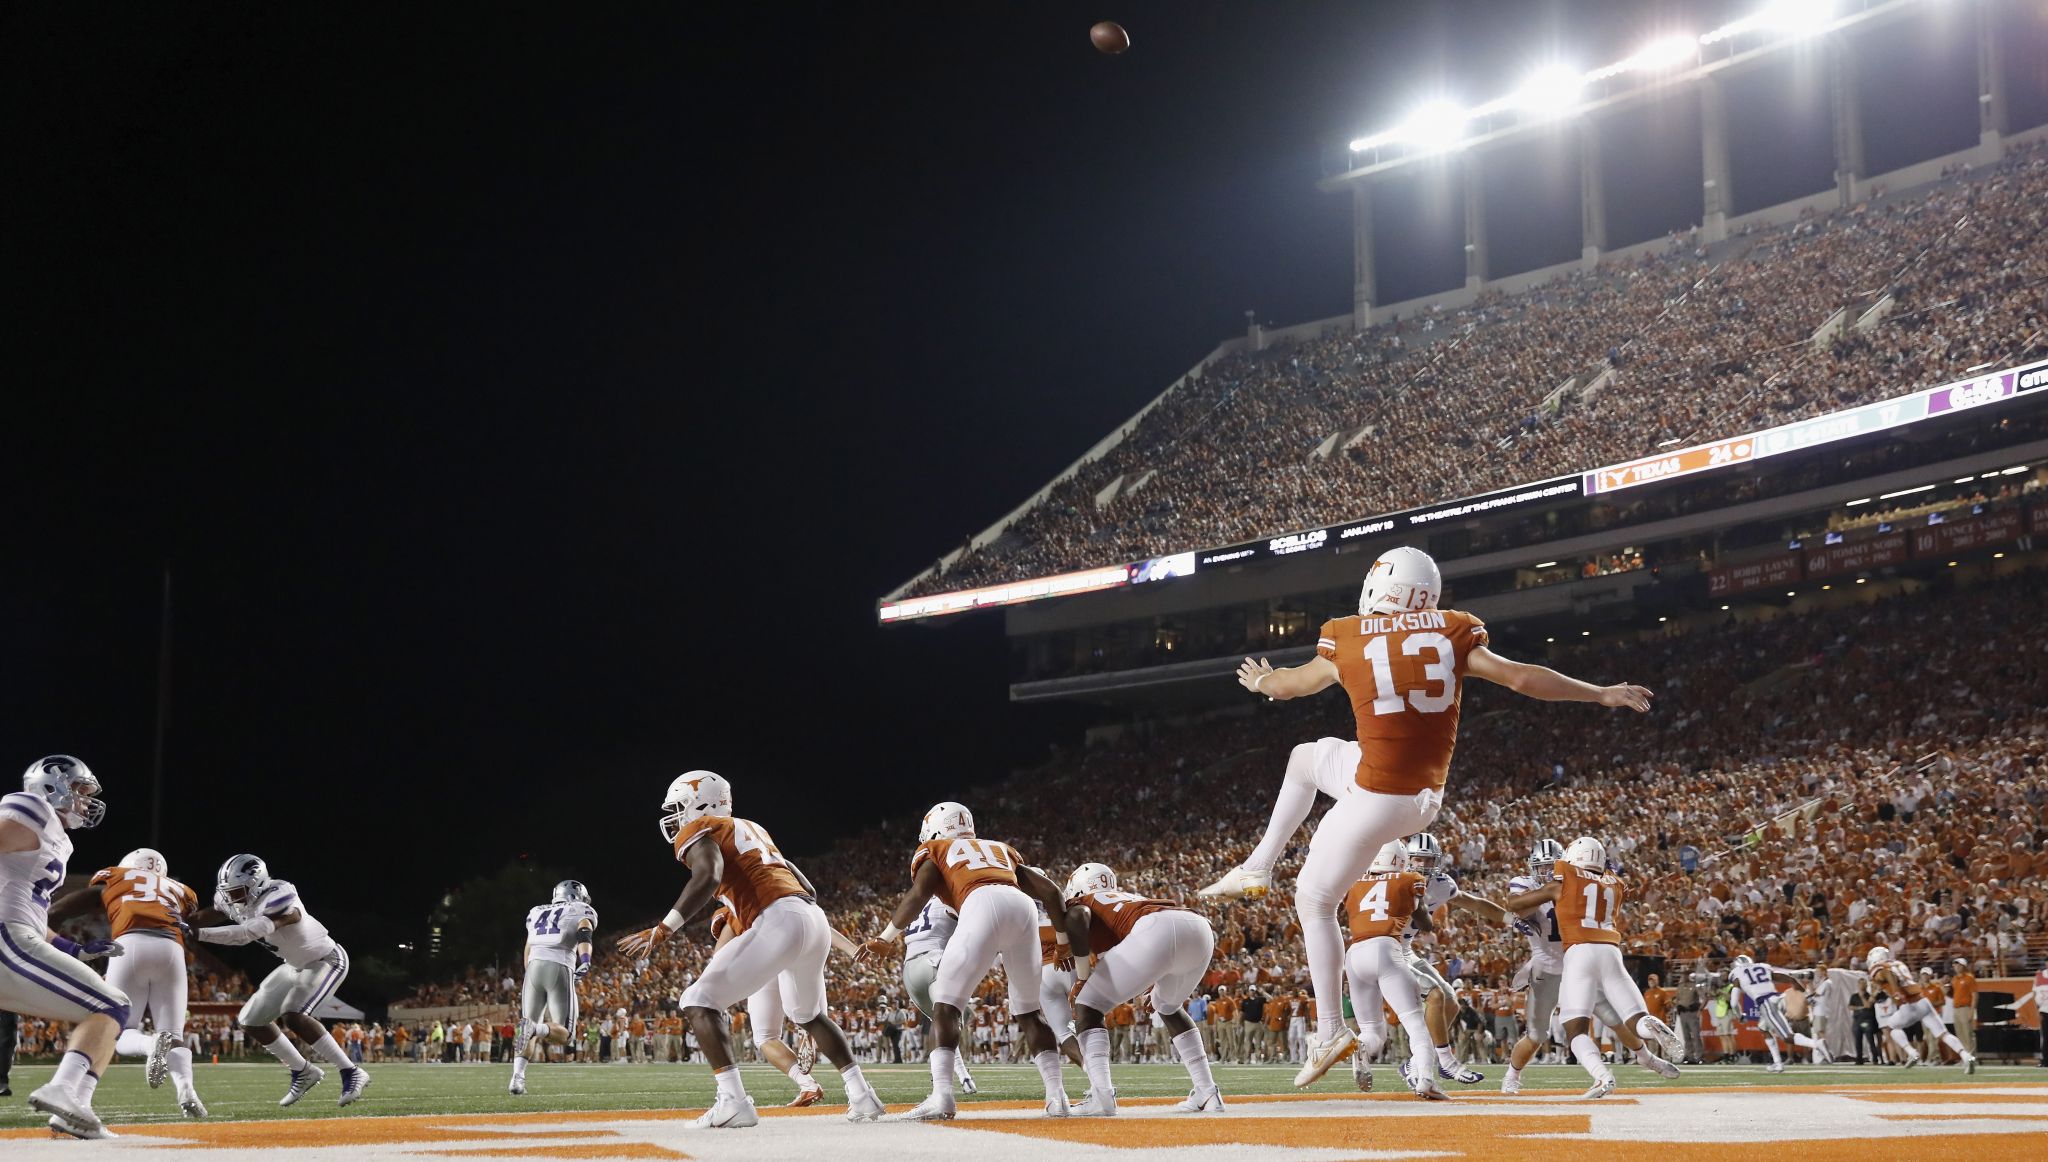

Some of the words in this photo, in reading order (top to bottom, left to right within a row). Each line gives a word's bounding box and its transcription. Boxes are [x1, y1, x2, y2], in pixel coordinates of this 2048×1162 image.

[1633, 457, 1681, 482] TEXAS
[1709, 446, 1732, 466] 24
[1410, 515, 1426, 524] THE
[1473, 502, 1489, 512] THE
[1489, 496, 1516, 508] FRANK
[1543, 483, 1577, 496] CENTER
[1341, 522, 1383, 538] JANUARY
[1941, 522, 1975, 538] VINCE
[1832, 544, 1869, 560] TOMMY
[1918, 535, 1934, 551] 10
[1212, 551, 1240, 563] EVENING
[1764, 559, 1796, 573] LAYNE
[1809, 555, 1826, 572] 60
[1711, 575, 1727, 591] 22
[1406, 587, 1428, 610] 13
[1360, 611, 1446, 636] DICKSON
[1363, 632, 1456, 716] 13
[147, 857, 162, 873] 35
[947, 838, 1015, 871] 40
[1359, 880, 1390, 922] 4
[1581, 883, 1615, 930] 11
[533, 907, 564, 935] 41
[1743, 965, 1772, 986] 12
